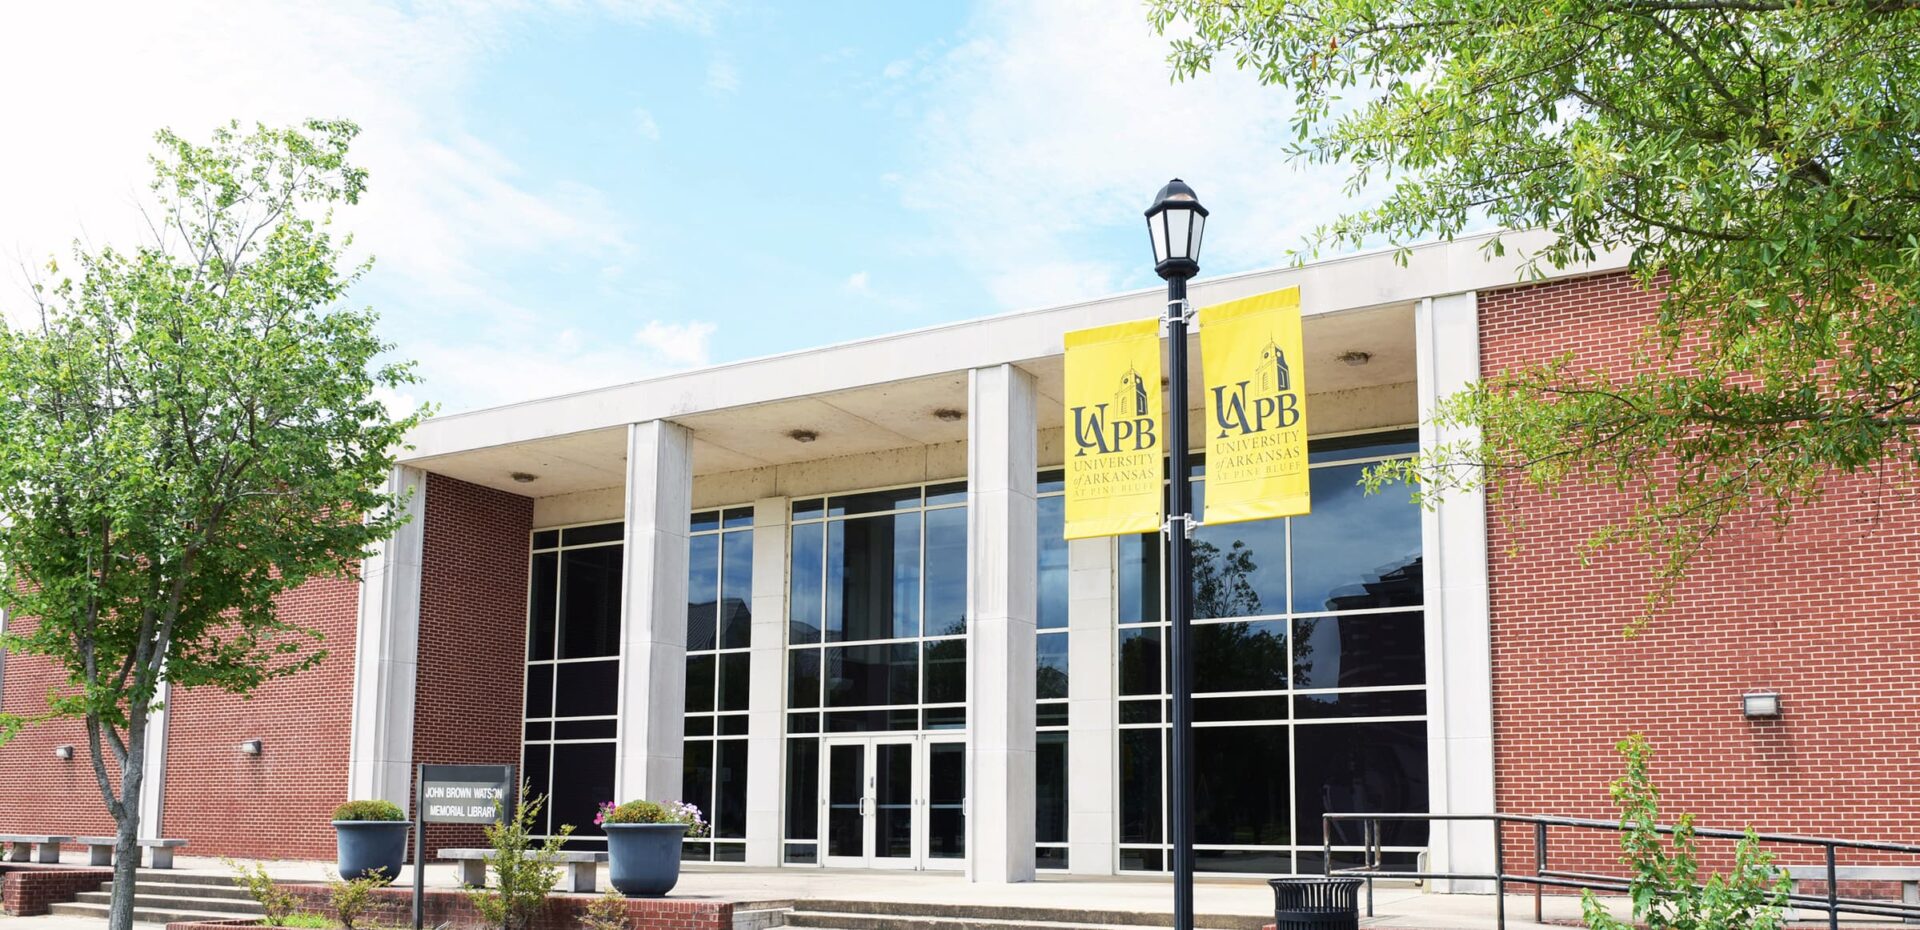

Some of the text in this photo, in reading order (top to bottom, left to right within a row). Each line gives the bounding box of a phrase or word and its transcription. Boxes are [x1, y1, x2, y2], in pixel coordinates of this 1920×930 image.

[1216, 429, 1299, 455] UNIVERSITY
[1073, 453, 1155, 472] UNIVERSITY
[1215, 446, 1300, 472] of ARKANSAS
[1073, 468, 1154, 489] of ARKANSAS
[1216, 461, 1301, 481] AT PINE BLUFF
[1074, 482, 1153, 497] AT PINE BLUFF
[425, 787, 503, 799] JOHN BROWN WATSON
[429, 805, 497, 818] MEMORIAL LIBRARY
